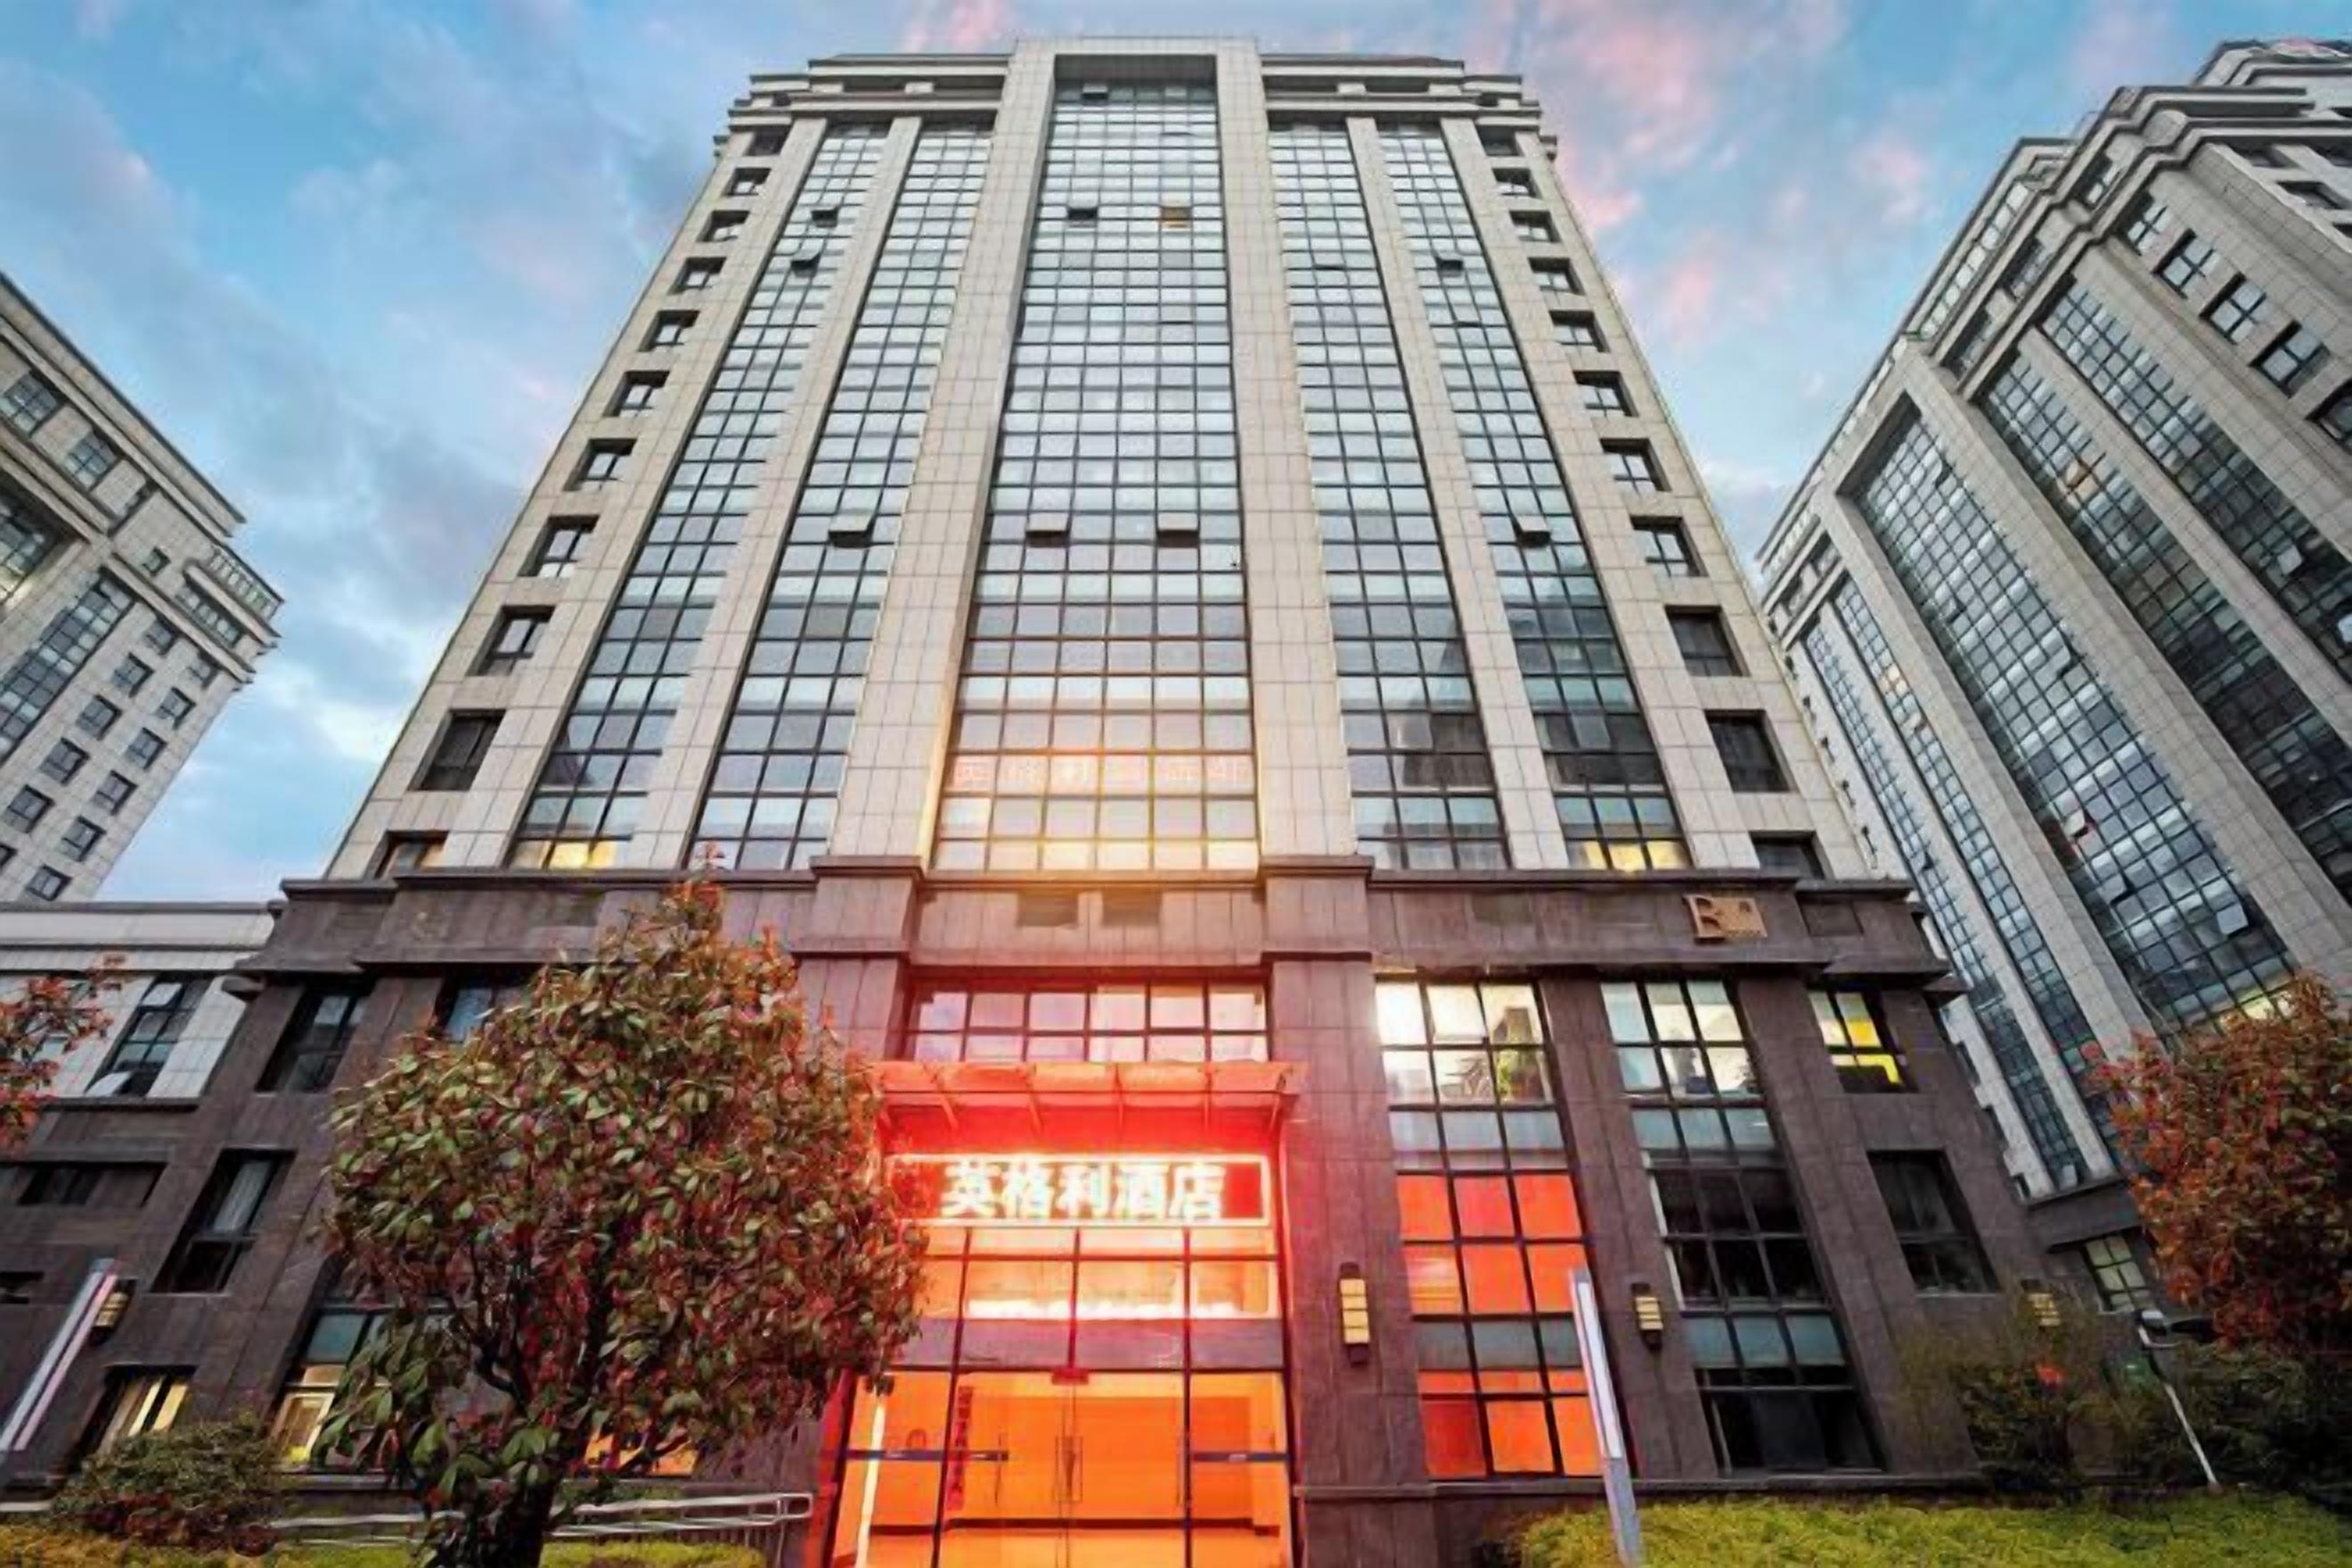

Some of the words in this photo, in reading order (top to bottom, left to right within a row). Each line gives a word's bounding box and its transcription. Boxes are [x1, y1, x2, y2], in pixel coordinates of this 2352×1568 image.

[941, 1156, 1226, 1221] 英格利酒店
